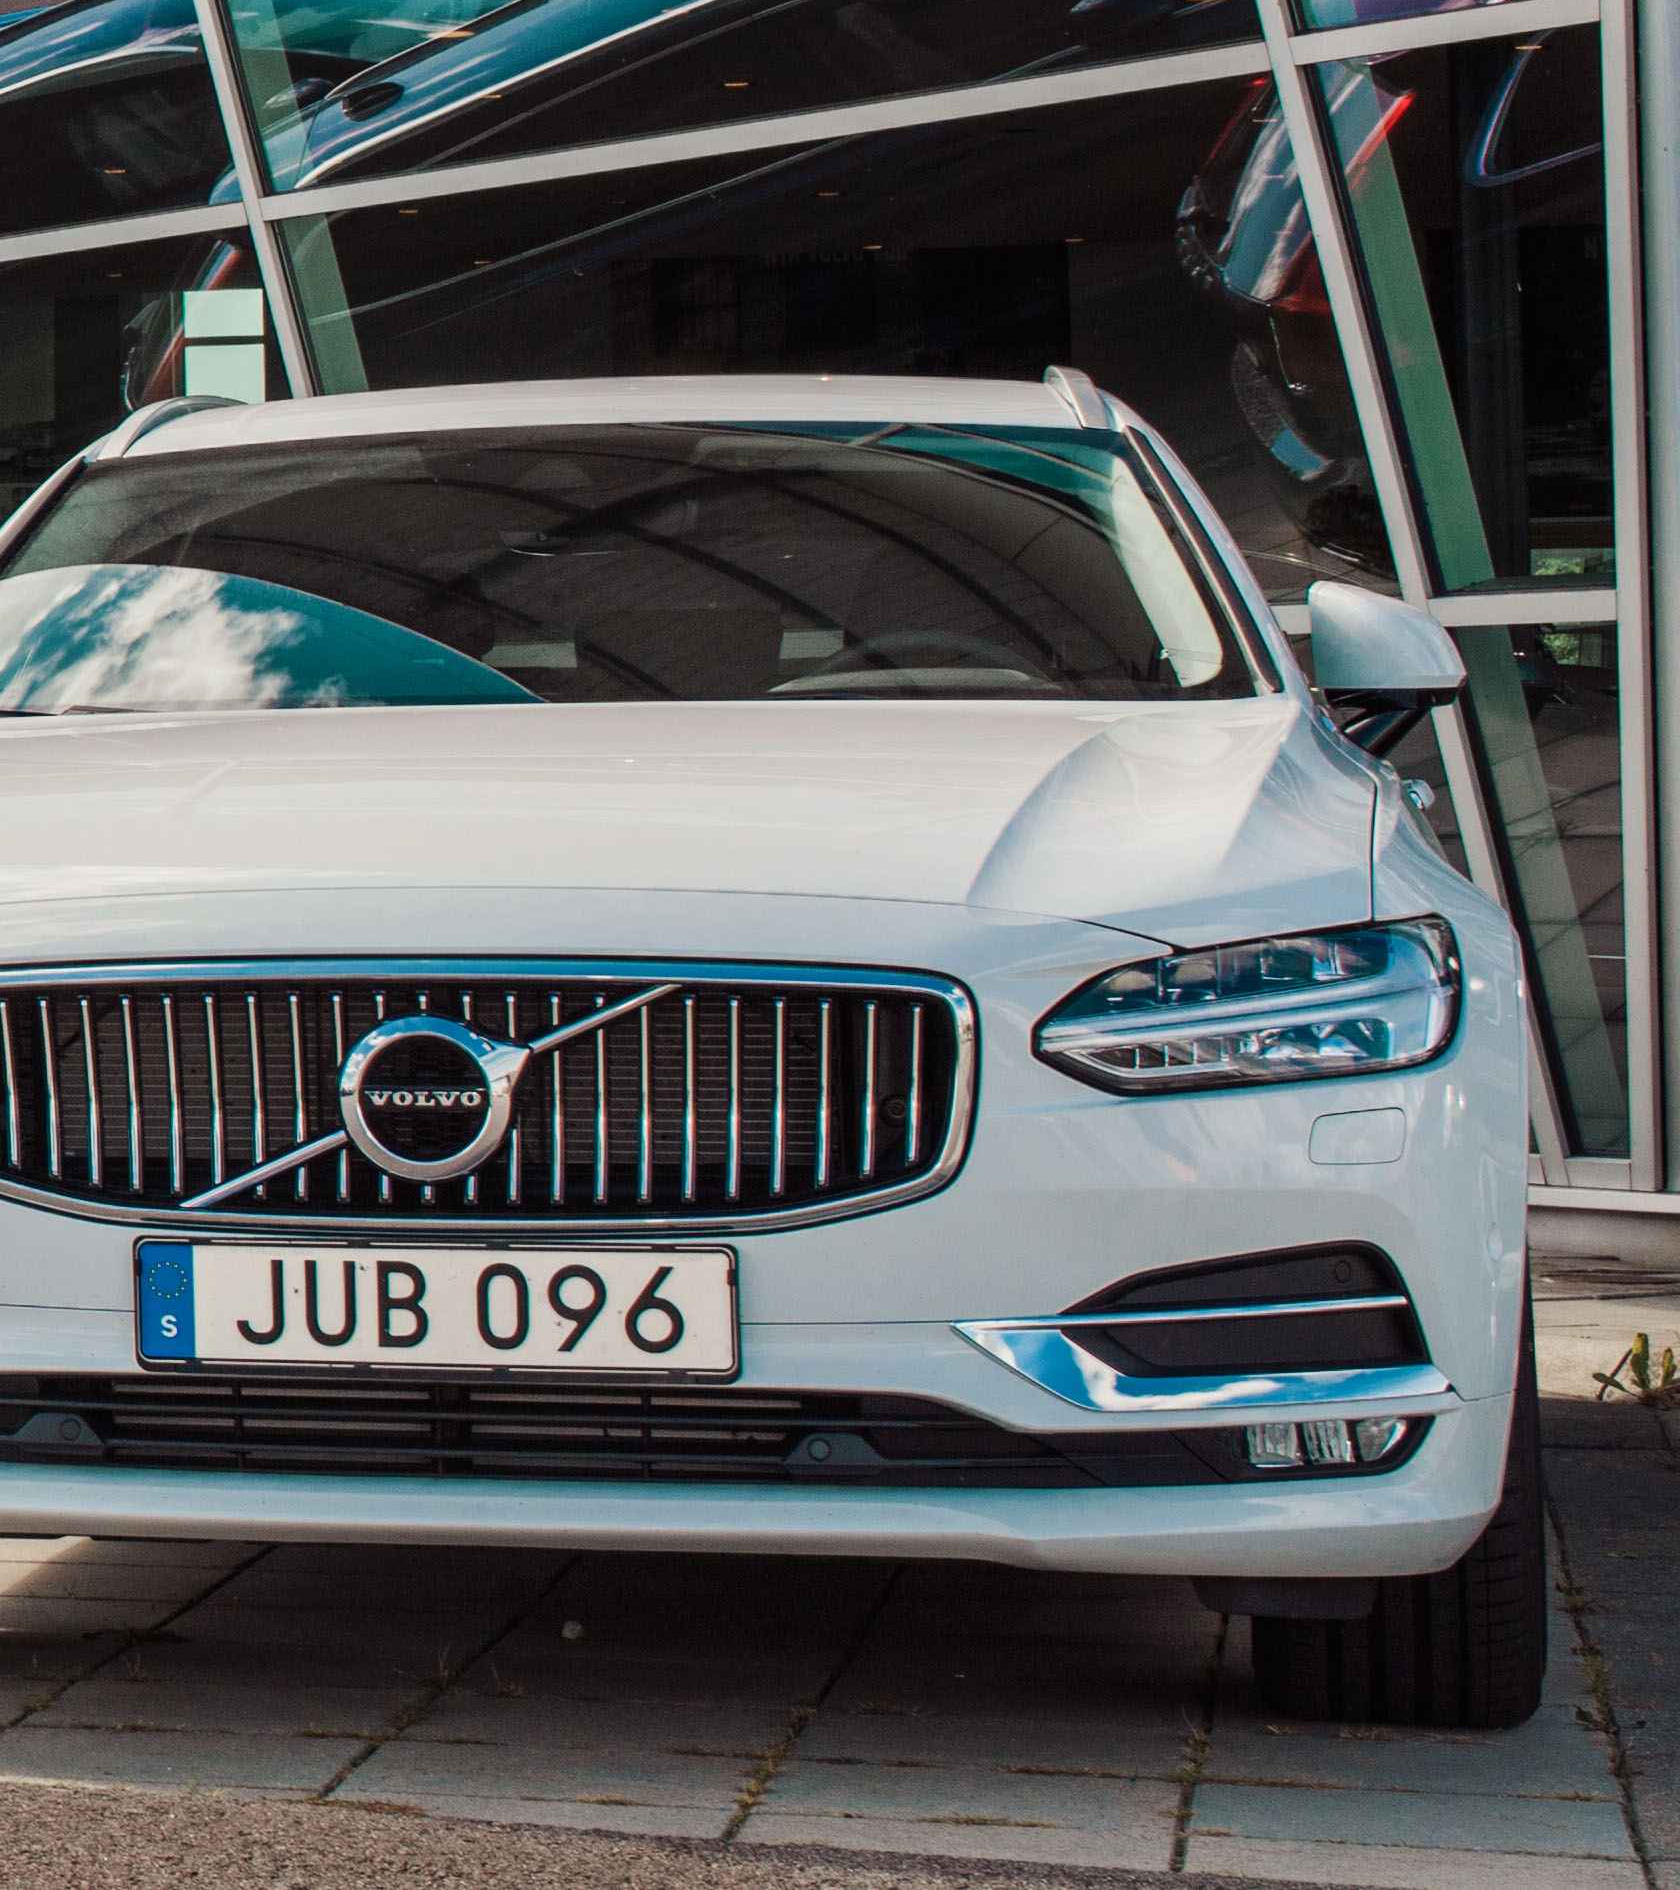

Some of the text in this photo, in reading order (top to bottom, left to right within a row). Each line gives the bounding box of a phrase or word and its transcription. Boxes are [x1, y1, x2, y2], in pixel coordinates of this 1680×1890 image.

[364, 1090, 482, 1107] VOLVO
[161, 1259, 685, 1353] S JUB 096
